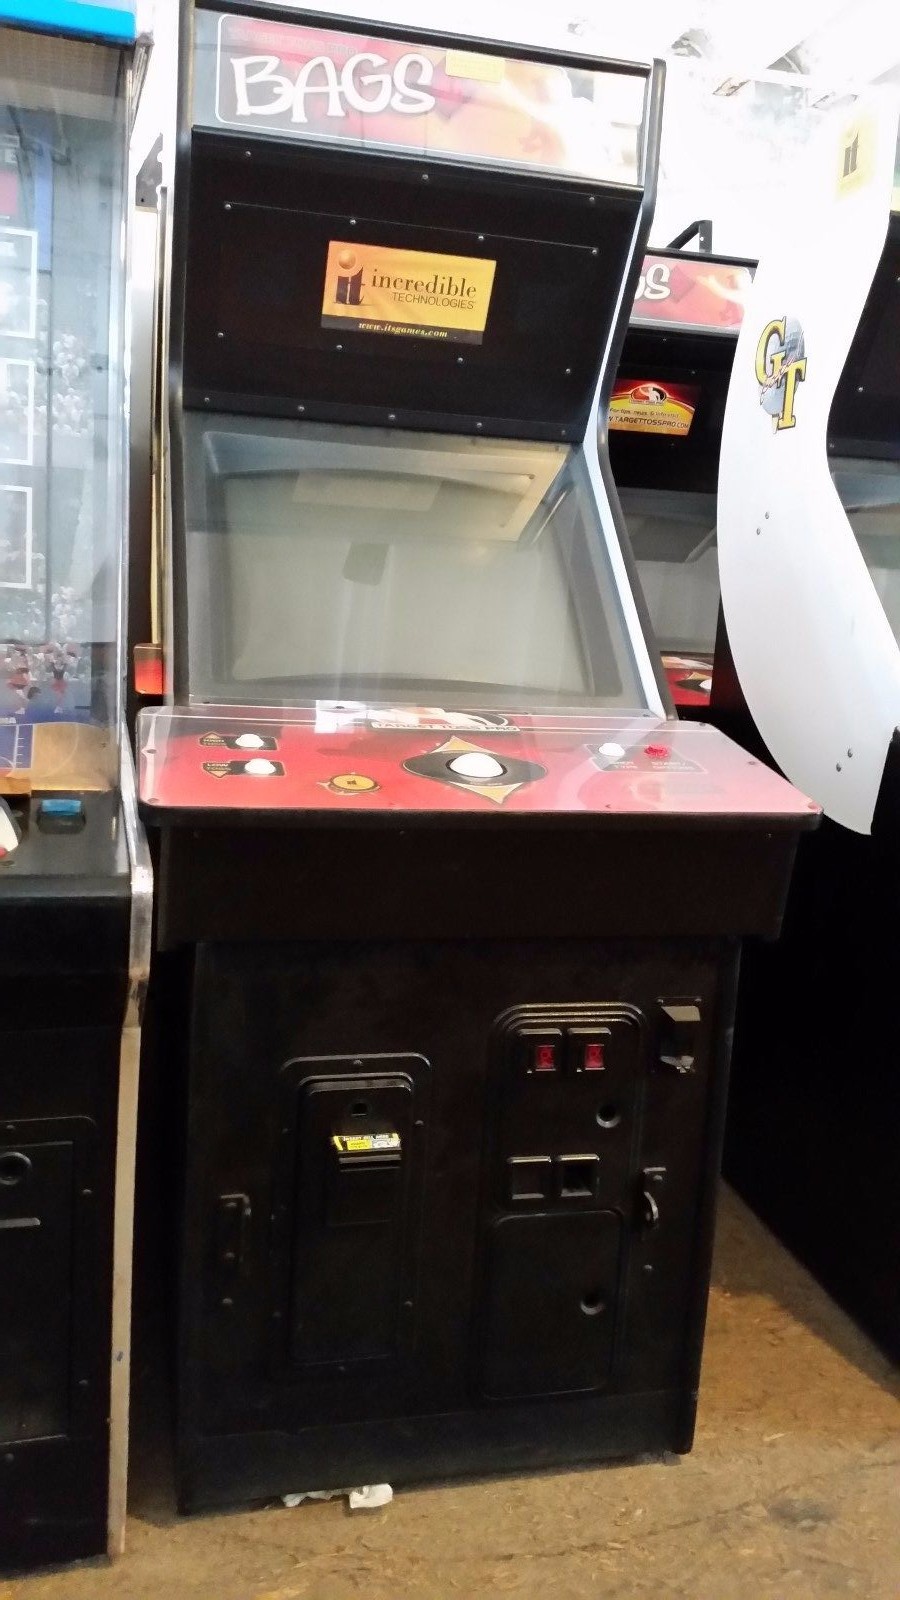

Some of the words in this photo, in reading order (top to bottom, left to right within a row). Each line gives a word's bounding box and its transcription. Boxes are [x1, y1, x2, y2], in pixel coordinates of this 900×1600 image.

[230, 52, 436, 123] BAGS
[371, 268, 477, 298] incredible
[392, 291, 475, 310] TECHNOLOGIES
[358, 322, 448, 338] www.itsgames.com
